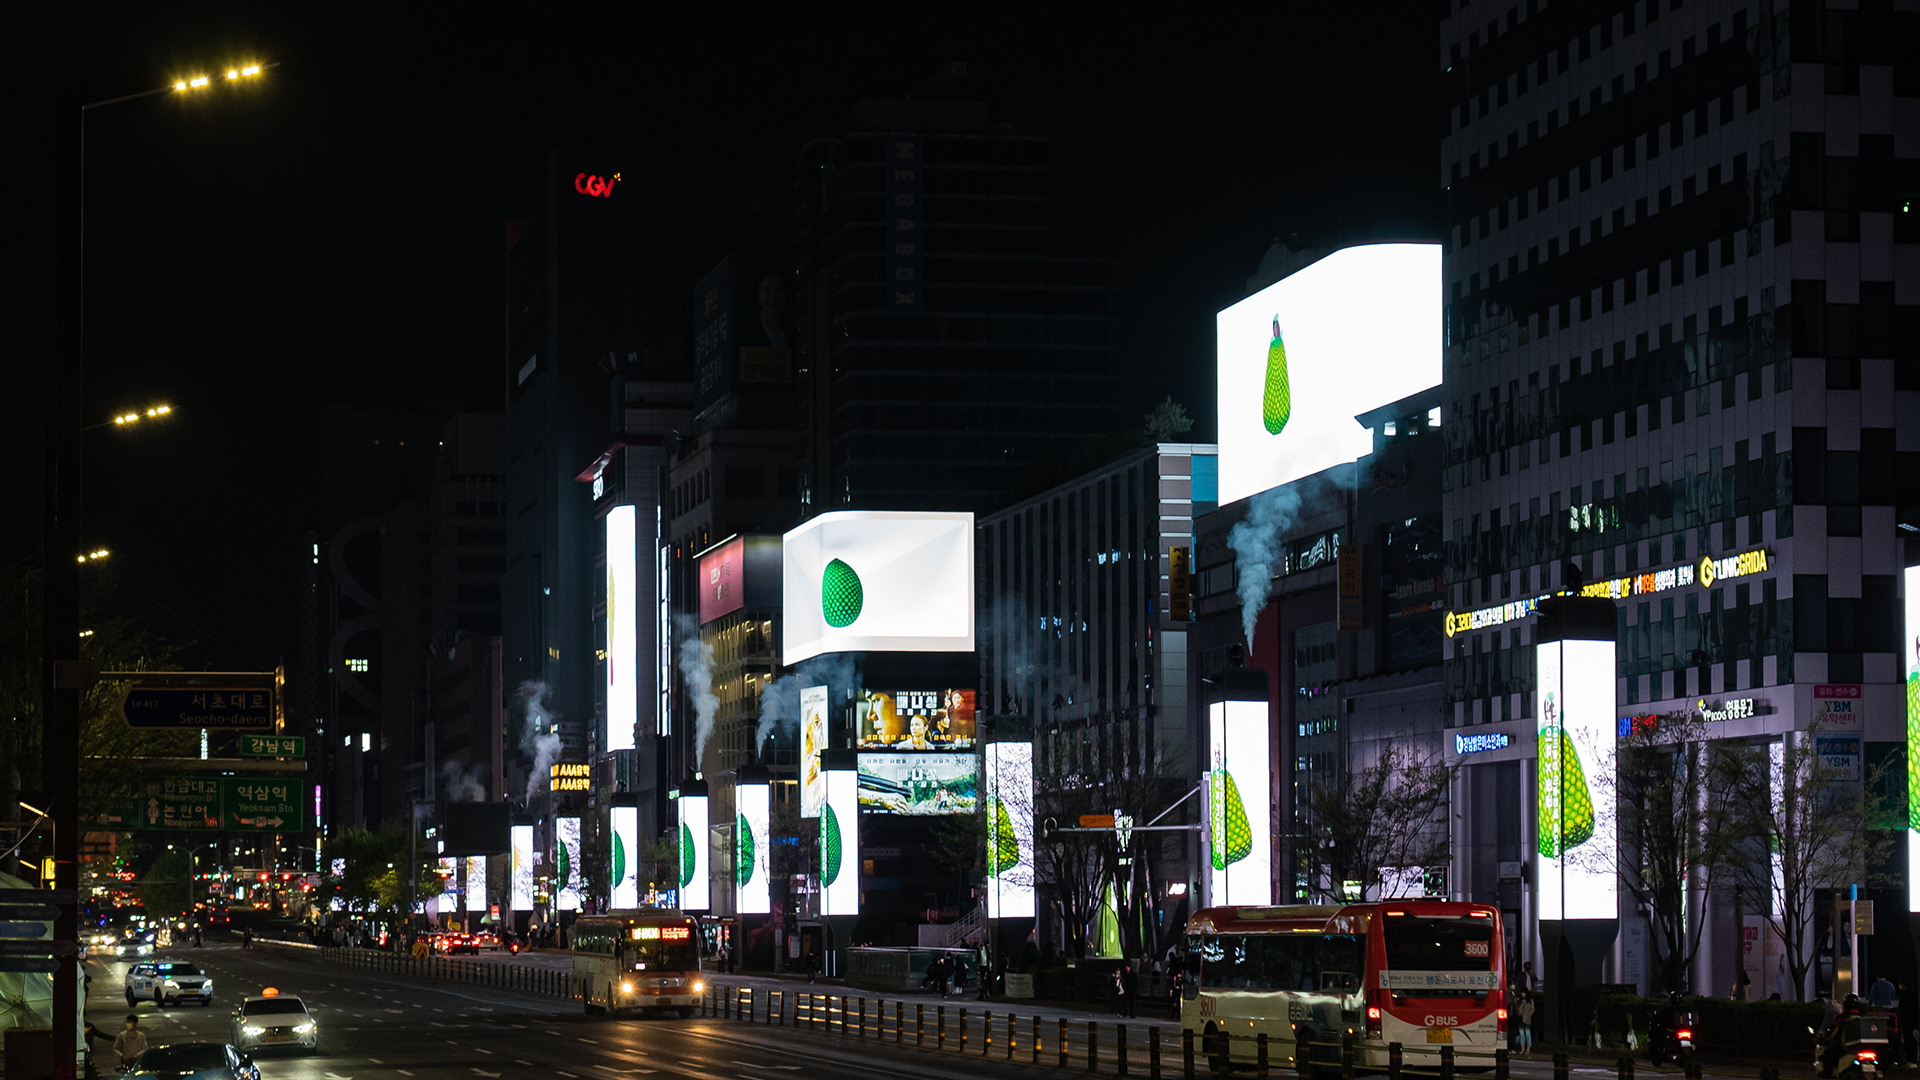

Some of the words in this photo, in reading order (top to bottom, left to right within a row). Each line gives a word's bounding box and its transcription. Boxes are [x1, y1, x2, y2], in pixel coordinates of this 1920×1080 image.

[575, 172, 615, 198] CGV
[893, 141, 915, 305] MEGABOX
[191, 693, 266, 710] 서초대로
[1825, 701, 1851, 712] YBM
[1726, 698, 1754, 720] 영풍문고
[179, 713, 266, 725] Seocho-daero
[1821, 713, 1856, 725] 유학센터
[251, 739, 296, 754] 강남역
[560, 764, 590, 777] AAA유학
[163, 781, 217, 794] 한남대교
[560, 778, 590, 791] AAA유학
[237, 786, 287, 802] 역삼역
[163, 804, 208, 819] 논현역
[238, 803, 276, 813] Yeoksam
[278, 803, 293, 813] Stn
[1465, 944, 1488, 955] 3600
[1424, 1014, 1435, 1026] G
[1436, 1016, 1458, 1025] BUS
